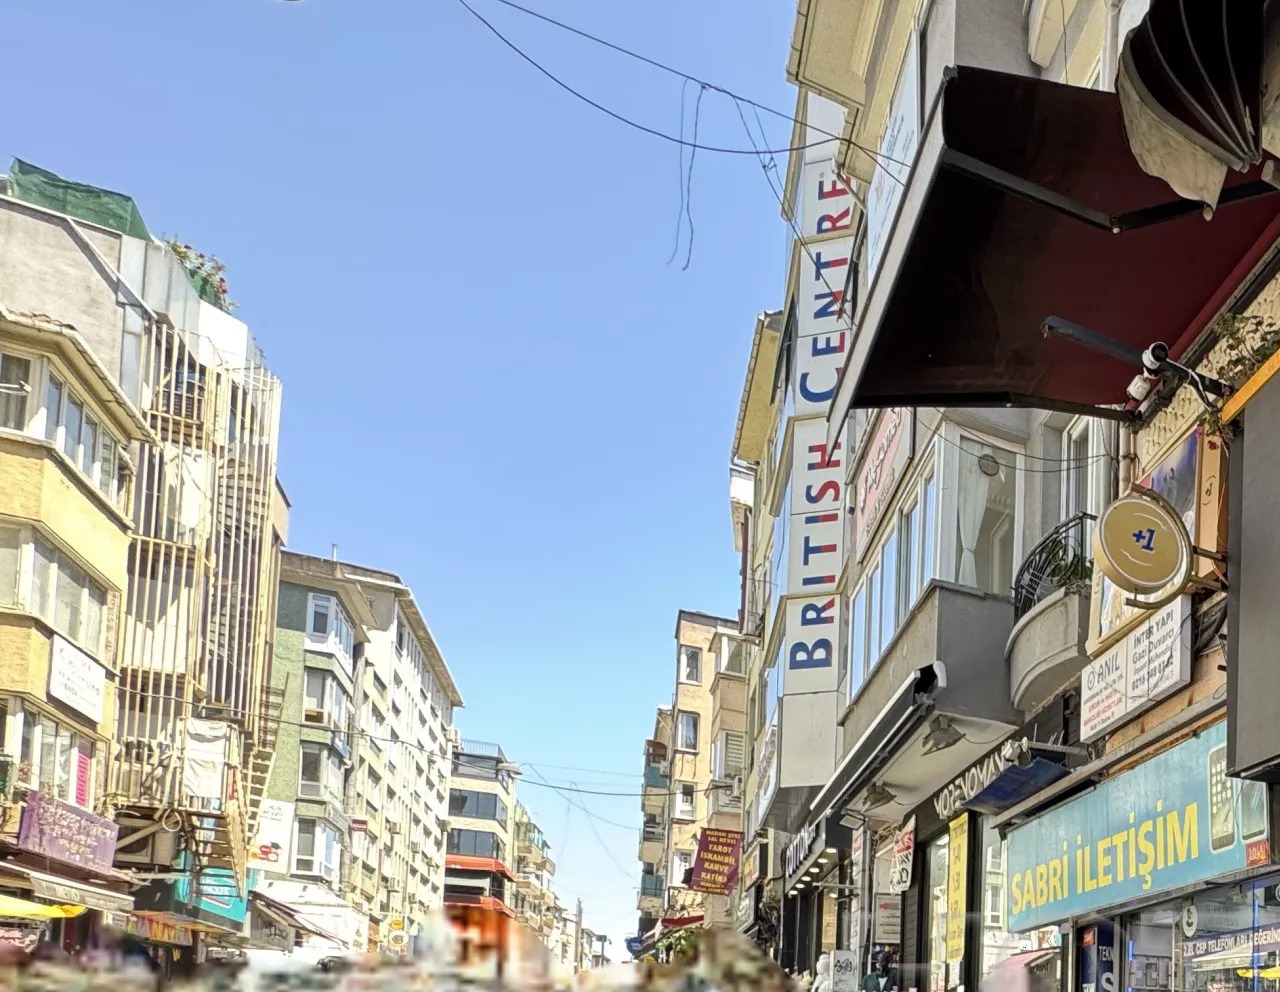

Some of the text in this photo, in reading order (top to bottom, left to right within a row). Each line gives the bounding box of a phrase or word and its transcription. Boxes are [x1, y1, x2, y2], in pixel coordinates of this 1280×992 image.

[789, 175, 852, 670] BRITISH CENTRE
[1156, 610, 1174, 631] YAPI
[1097, 652, 1121, 684] ANIL
[708, 844, 733, 853] TAROT
[1011, 841, 1069, 914] SABRİ
[1076, 800, 1198, 890] İLETİŞİM
[704, 861, 729, 873] KAHVE
